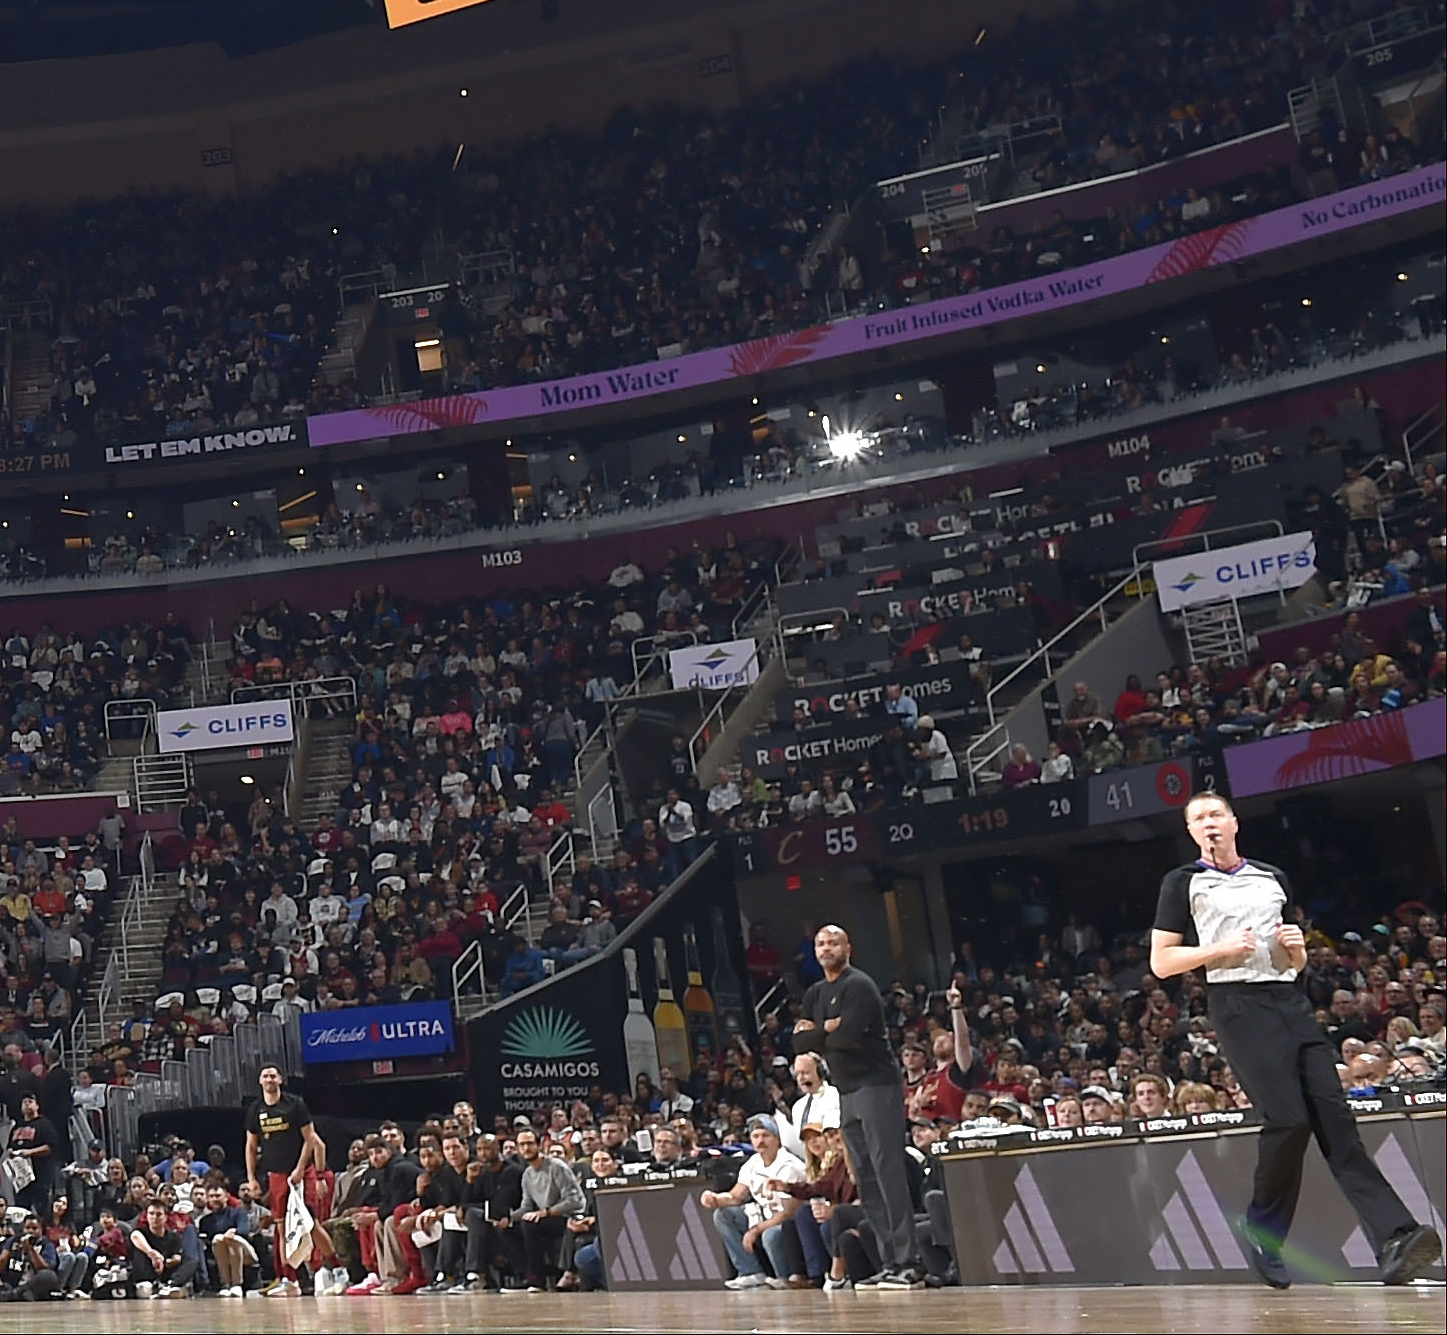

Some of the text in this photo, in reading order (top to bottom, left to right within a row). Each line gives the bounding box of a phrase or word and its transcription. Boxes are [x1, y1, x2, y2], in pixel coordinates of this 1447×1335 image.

[1302, 177, 1446, 228] No Carbonatio
[864, 274, 1105, 339] Fruit Infused Vodka Water
[540, 366, 680, 409] Mom Water
[105, 426, 297, 463] LET EM KNOW.
[1108, 434, 1151, 459] M104
[1215, 550, 1314, 586] CLIFFS
[902, 676, 952, 698] omes
[207, 712, 288, 736] CLIFFS
[756, 738, 831, 766] ROCKET
[825, 826, 858, 856] 55
[890, 823, 913, 844] 2Q
[1049, 797, 1071, 818] 20
[1107, 782, 1134, 811] 41
[307, 1018, 445, 1047] Michelob ULTRA
[501, 1063, 600, 1078] CASAMIGOS
[503, 1086, 589, 1097] BROUGHT TO YOU
